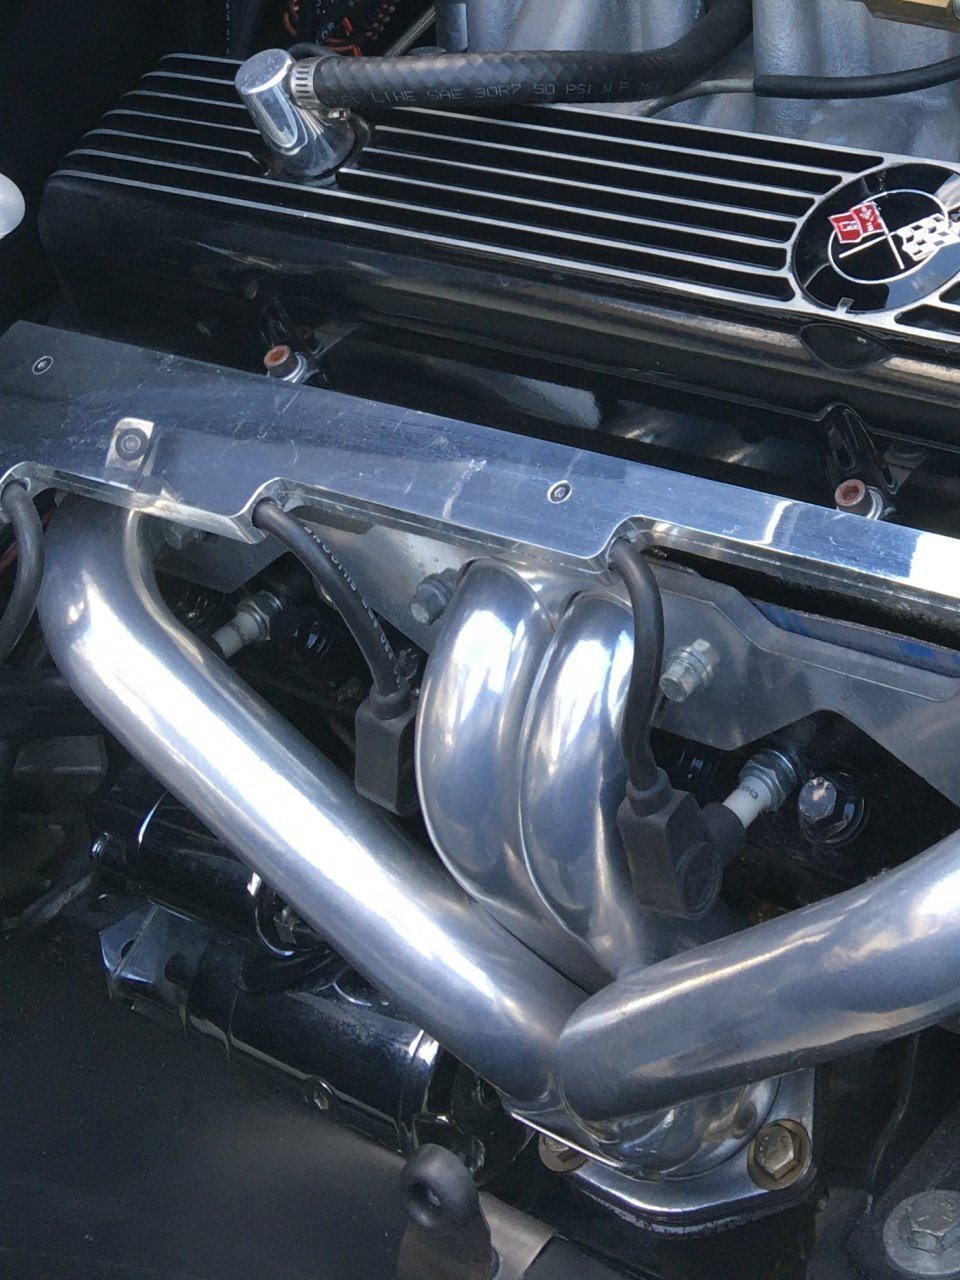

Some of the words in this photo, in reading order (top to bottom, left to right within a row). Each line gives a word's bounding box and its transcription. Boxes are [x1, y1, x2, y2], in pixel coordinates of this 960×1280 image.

[371, 90, 417, 104] LINE
[426, 88, 463, 100] SAE
[565, 83, 592, 95] PSI
